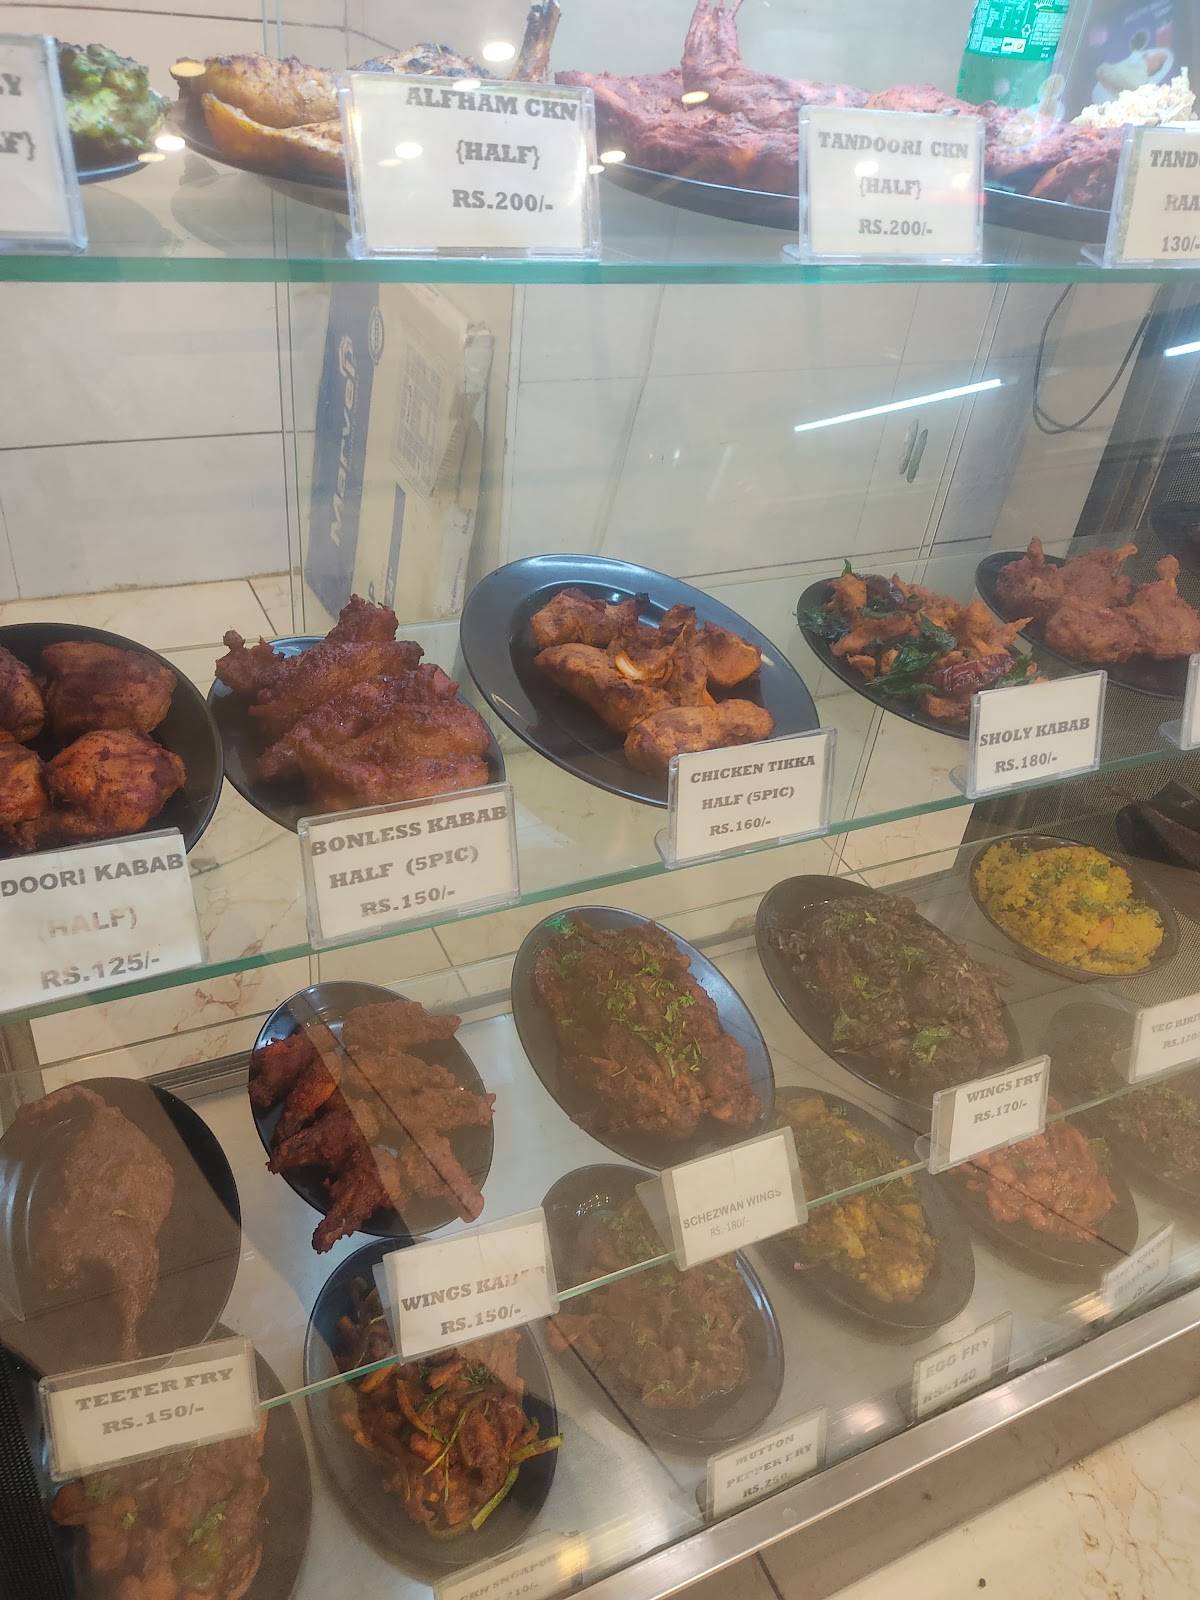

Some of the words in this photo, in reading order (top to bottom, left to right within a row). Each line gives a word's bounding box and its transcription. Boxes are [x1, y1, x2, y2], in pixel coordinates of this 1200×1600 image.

[405, 87, 518, 115] ALFHAM
[525, 98, 578, 121] CKN
[456, 140, 540, 170] {HALF}
[818, 131, 922, 156] TANDOORI
[930, 141, 969, 159] CKN
[1150, 149, 1200, 169] TAND
[452, 189, 554, 213] RS.200/-
[859, 176, 922, 200] {HALF}
[858, 218, 933, 236] RS.200/-
[979, 726, 1034, 748] SHOLY
[1035, 717, 1091, 737] KABAB
[690, 763, 764, 785] CHICKEN
[767, 754, 816, 774] TIKKA
[994, 751, 1058, 774] RS.180/-
[701, 793, 744, 811] HALF
[746, 786, 795, 806] (5PIC)
[311, 822, 422, 856] BONLESS
[427, 805, 508, 834] KABAB
[709, 815, 772, 837] RS.160/-
[0, 868, 86, 898] DOORI
[94, 853, 184, 883] KABAB
[329, 862, 394, 889] HALF
[405, 845, 479, 877] (5PIC)
[360, 885, 455, 918] RS.150/-
[38, 906, 138, 944] (HALF)
[40, 951, 161, 990] RS.125/-
[966, 1080, 1013, 1104] WINGS
[1014, 1071, 1042, 1089] FRY
[973, 1099, 1029, 1125] RS.170/-
[682, 1199, 744, 1230] SCHEZWAN
[747, 1189, 783, 1207] WINGS
[401, 1283, 472, 1312] WINGS
[440, 1303, 521, 1336] RS.150/-
[926, 1354, 957, 1379] EGG
[962, 1337, 991, 1361] FRY
[75, 1378, 179, 1412] TEETER
[184, 1367, 235, 1389] FRY
[102, 1402, 205, 1436] RS.150/-
[736, 1434, 795, 1466] MUTTON
